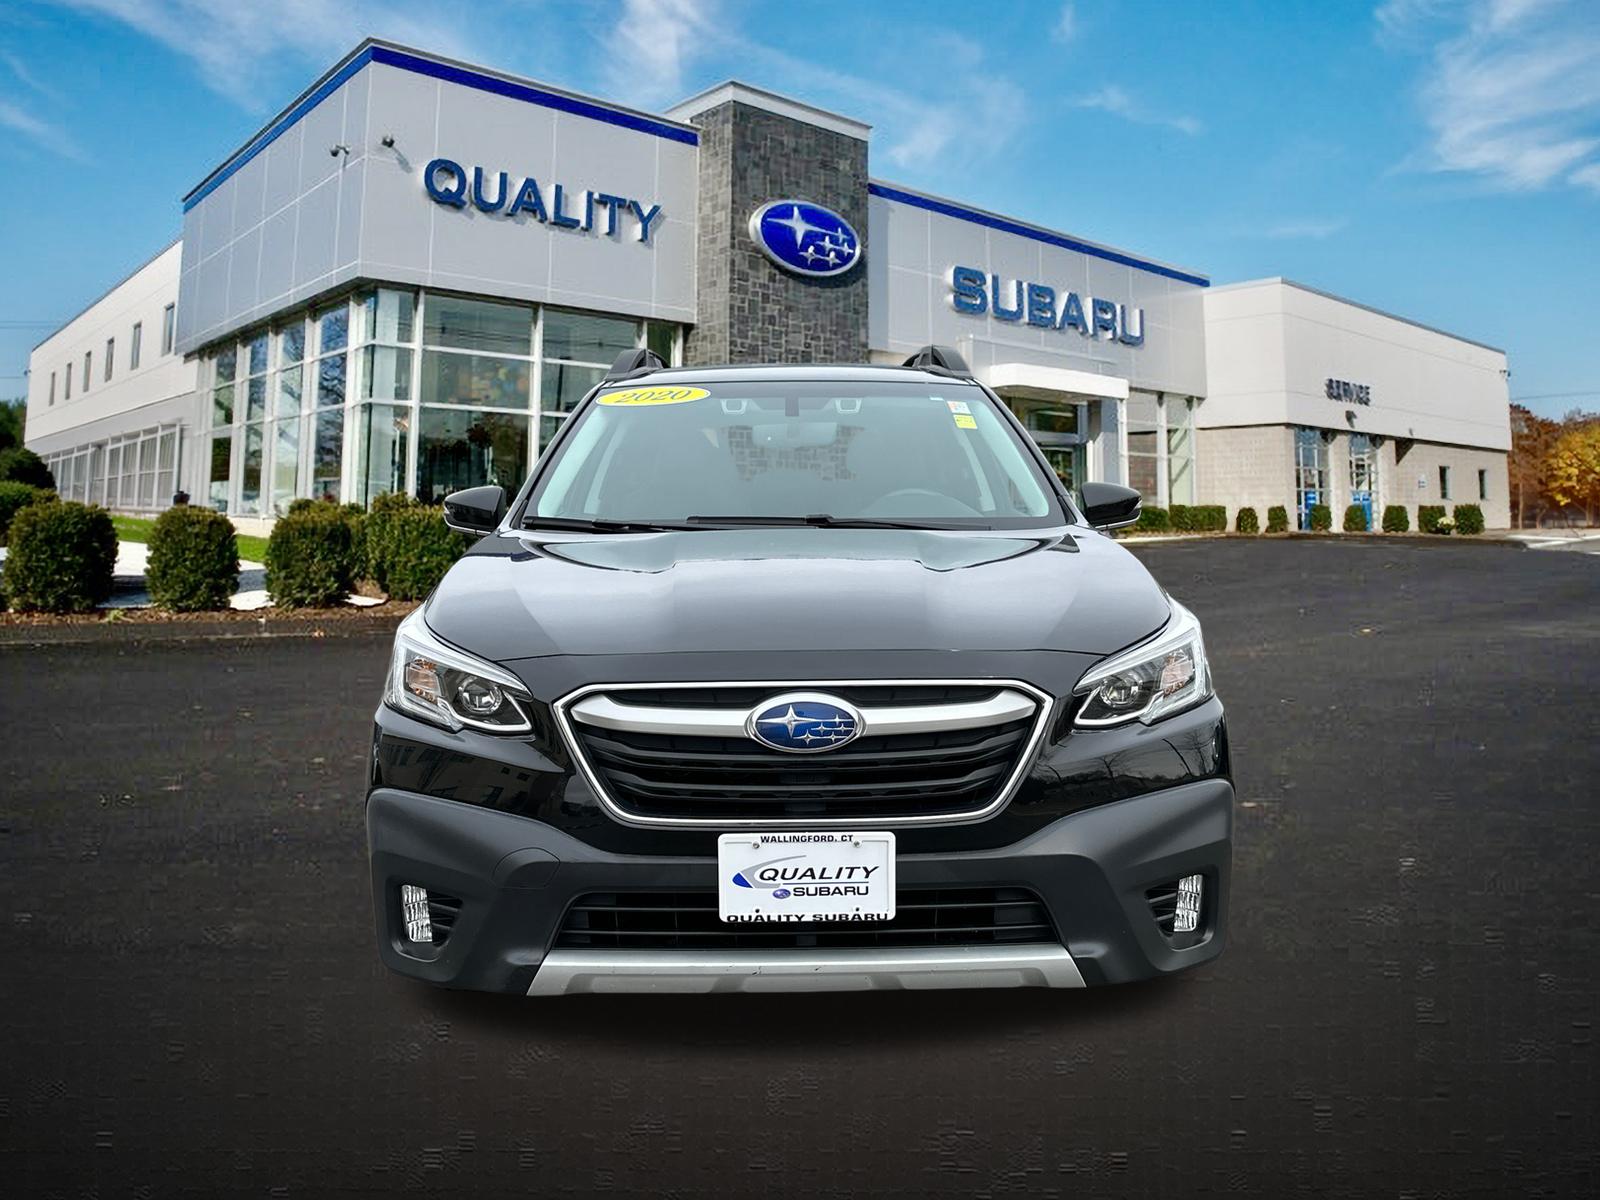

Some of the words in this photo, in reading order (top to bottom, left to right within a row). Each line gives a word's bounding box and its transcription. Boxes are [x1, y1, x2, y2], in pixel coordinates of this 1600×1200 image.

[424, 158, 662, 243] QUALITY
[950, 265, 1145, 346] SUBARU
[614, 390, 692, 403] 2020
[1325, 377, 1371, 406] SERVICE
[841, 834, 854, 842] CT
[759, 866, 879, 882] QUALITY
[793, 886, 869, 897] SUBARU
[726, 914, 805, 923] QUALITY
[812, 913, 888, 921] SUBARU
